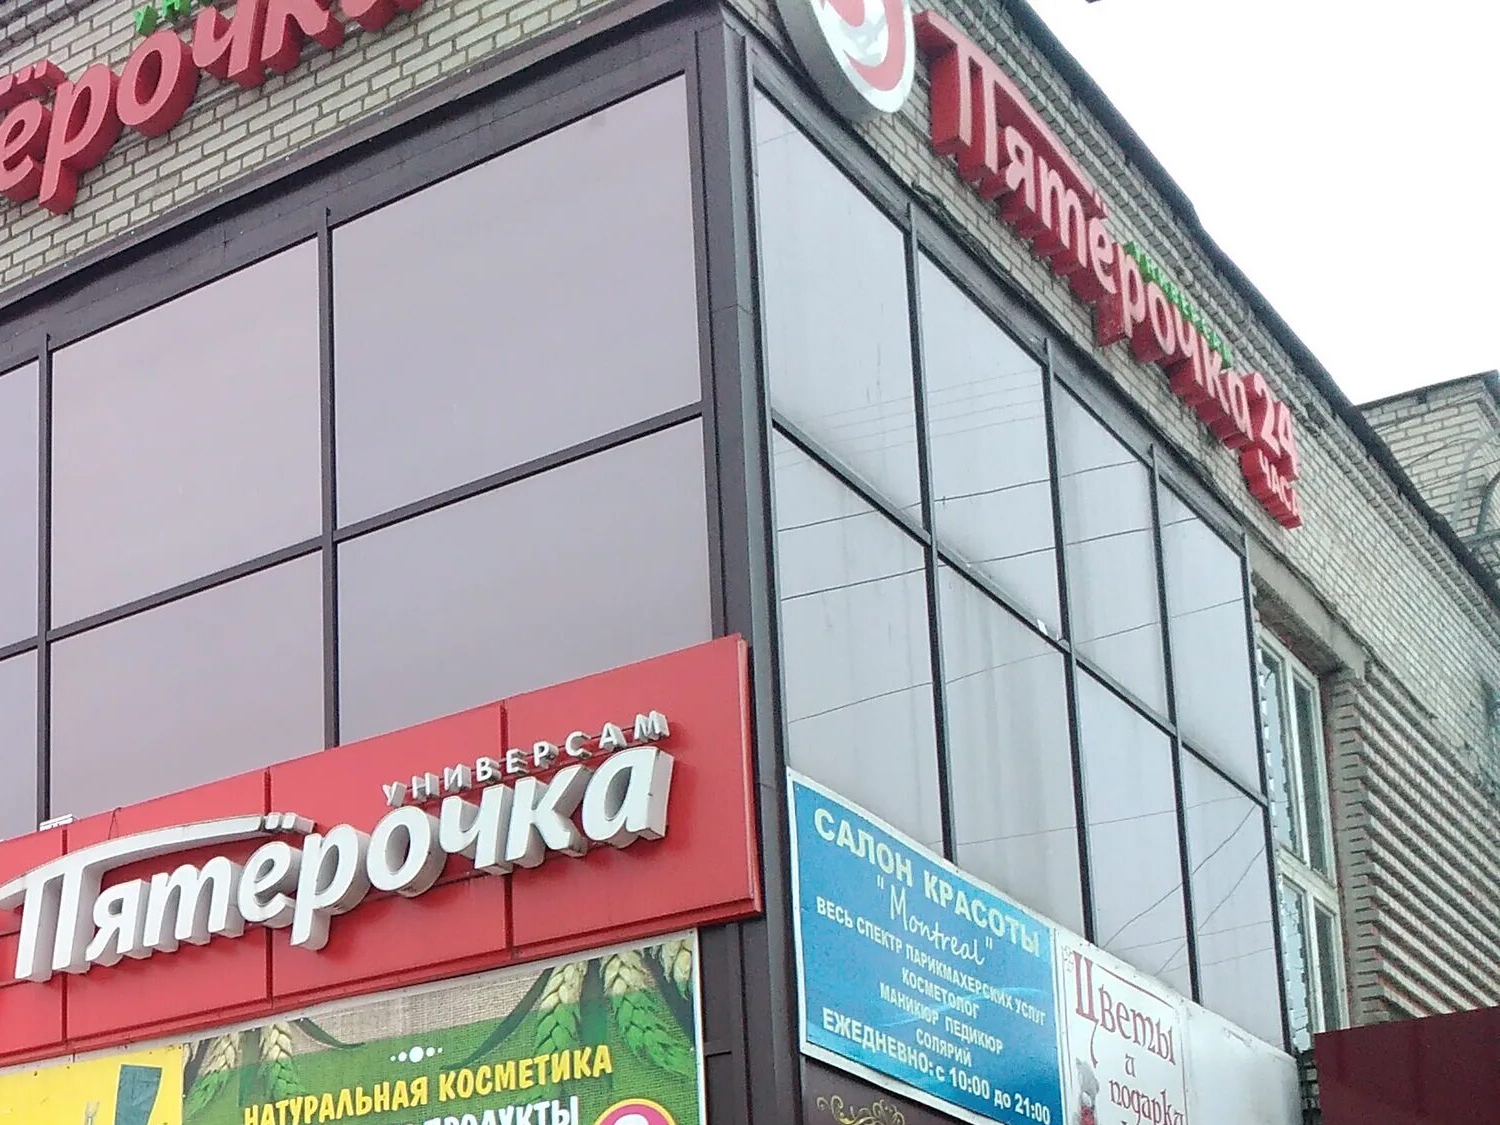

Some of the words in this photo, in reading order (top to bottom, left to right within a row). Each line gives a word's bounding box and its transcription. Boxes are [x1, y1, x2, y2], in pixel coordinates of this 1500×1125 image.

[918, 10, 1253, 442] Пятёрочка
[1253, 370, 1299, 480] 24
[381, 711, 671, 806] УНИВЕРСАМ
[814, 808, 913, 886] САЛОН
[924, 869, 1040, 957] КРАСОТЫ
[816, 896, 853, 928] ВЕСЬ
[856, 916, 902, 953] СПЕКТР
[906, 943, 1013, 1009] ПАРИКМАХЕРСКИХ
[1015, 999, 1046, 1026] УСЛУГ
[901, 967, 980, 1018] КОСМЕТОЛОГ
[1072, 950, 1176, 1068] Цветы
[822, 1007, 934, 1076] ЕЖЕДНЕВНО:
[950, 1065, 990, 1100] 10:00
[994, 1089, 1011, 1111] до
[1014, 1093, 1050, 1125] 21:00
[879, 982, 939, 1026] МАНИКЮР
[944, 1016, 1003, 1054] ПЕДИКЮР
[916, 1028, 972, 1067] СОЛЯРИЙ
[438, 1045, 613, 1102] КОСМЕТИКА
